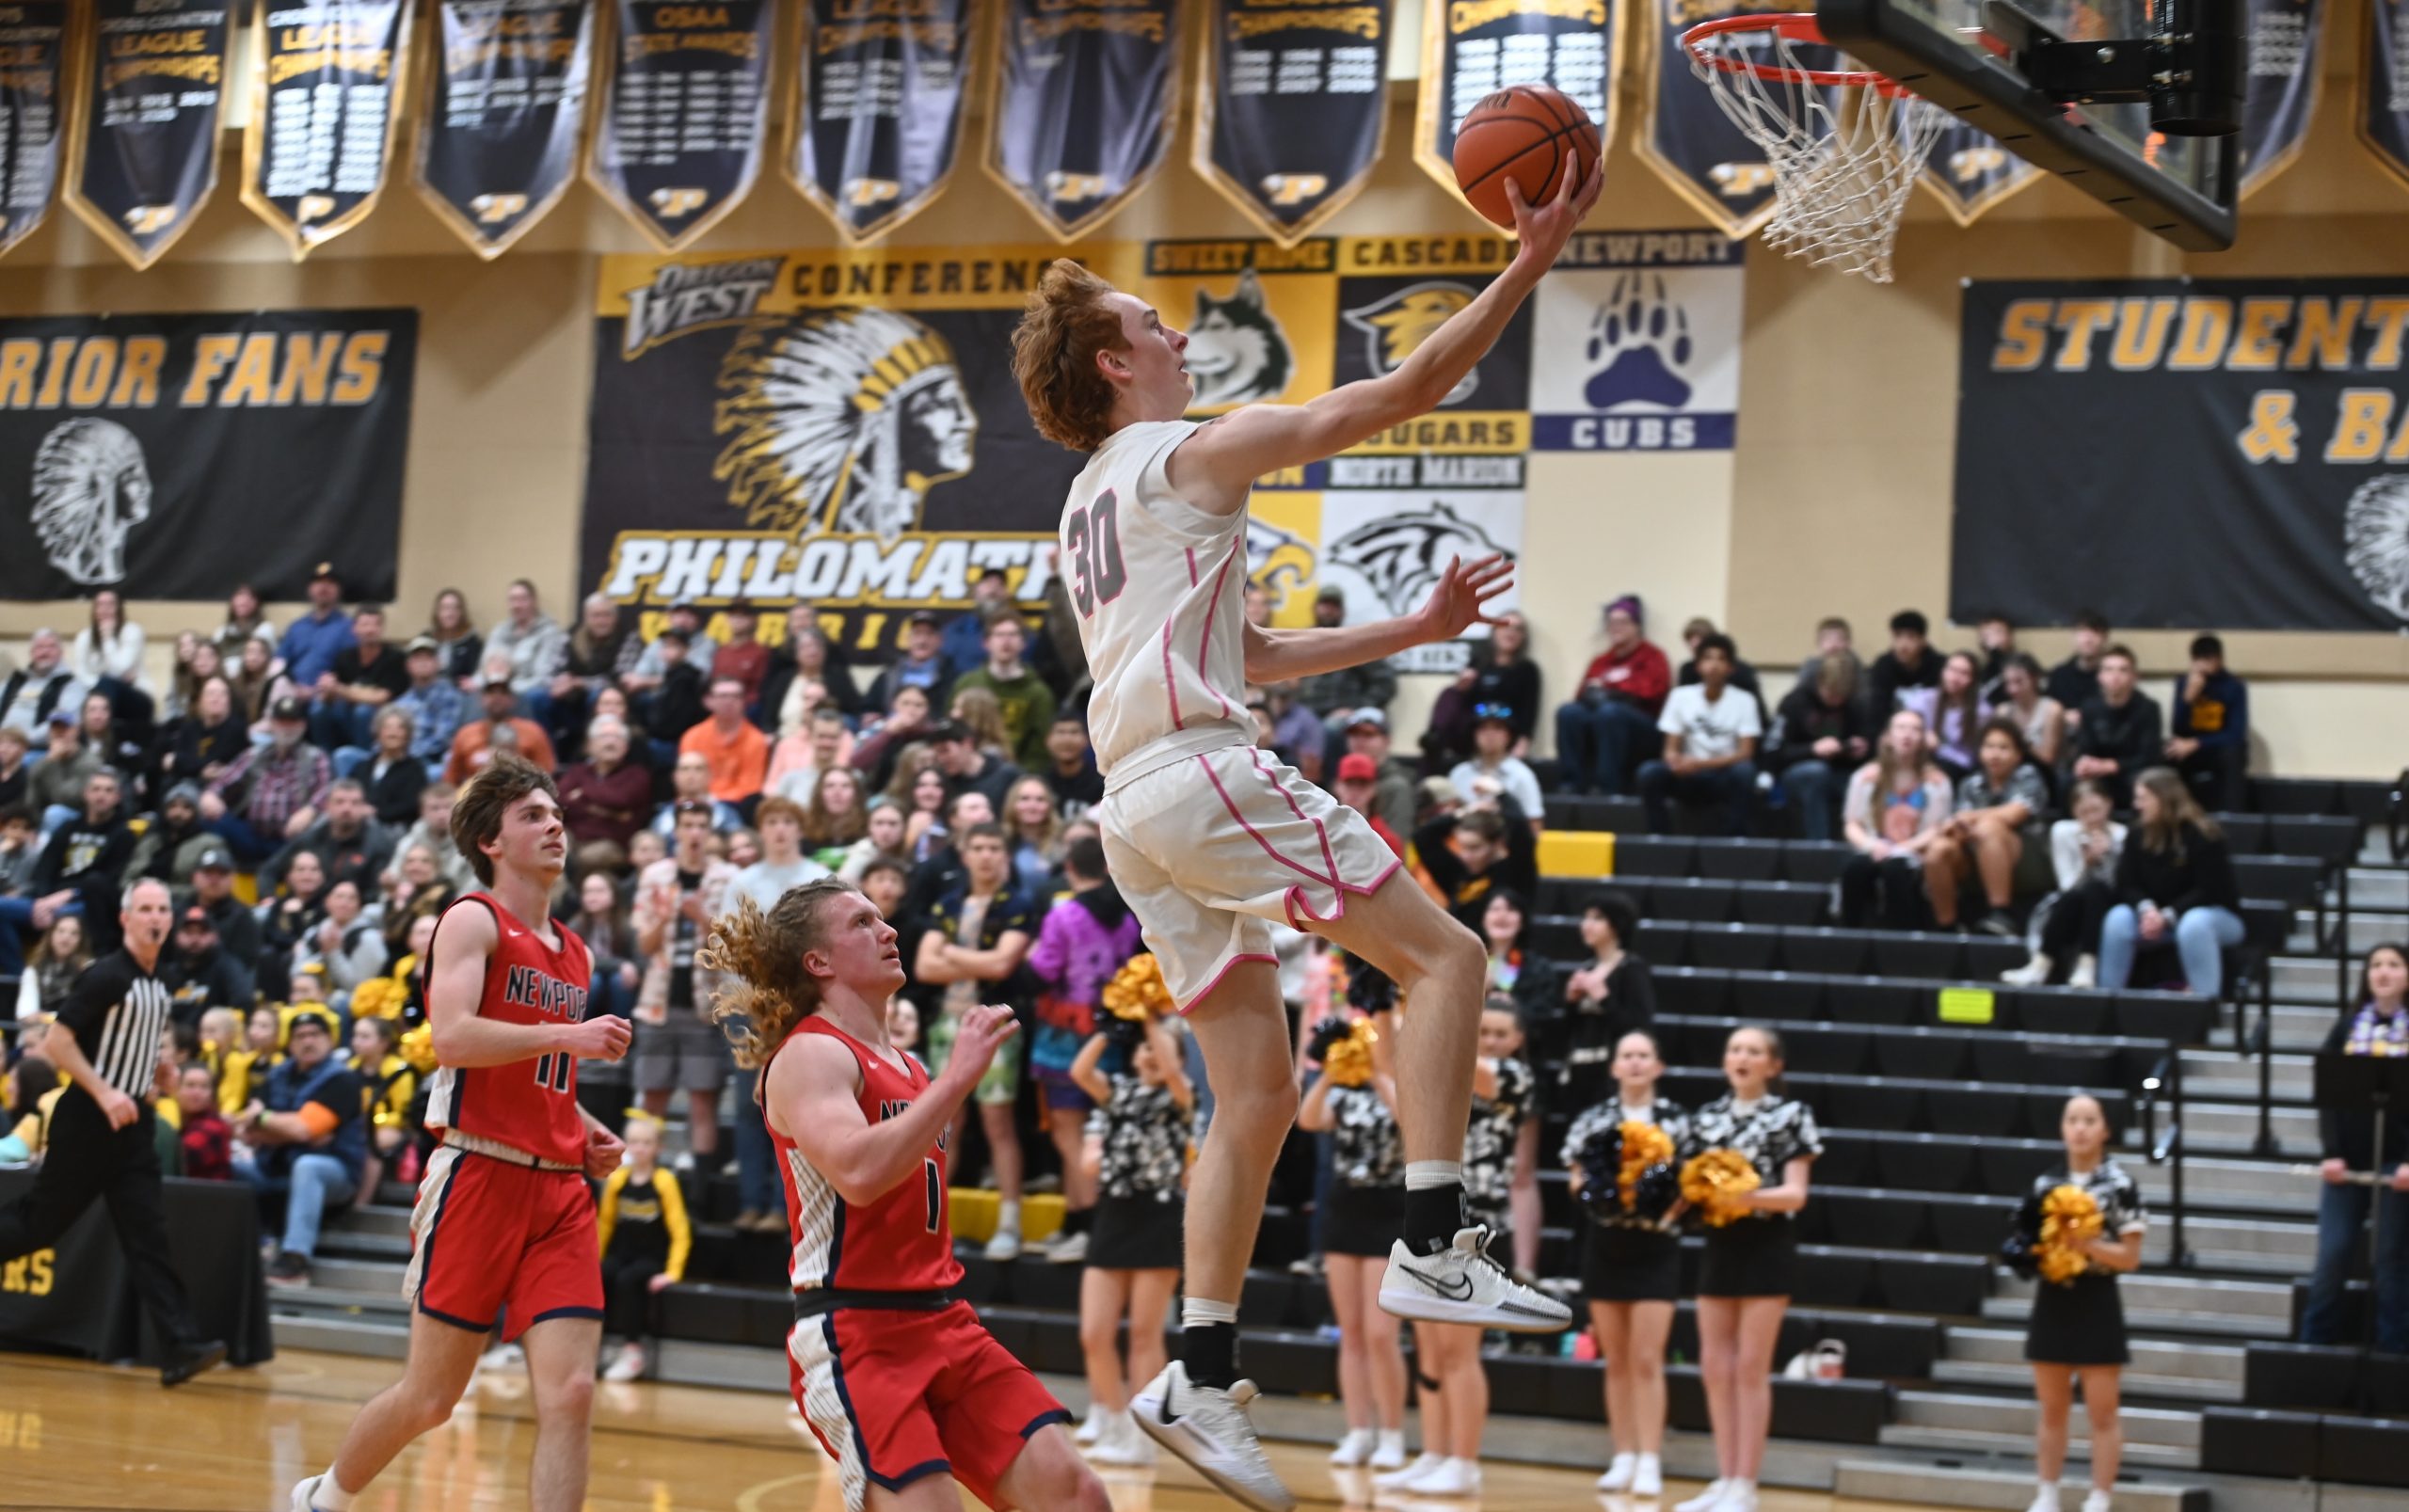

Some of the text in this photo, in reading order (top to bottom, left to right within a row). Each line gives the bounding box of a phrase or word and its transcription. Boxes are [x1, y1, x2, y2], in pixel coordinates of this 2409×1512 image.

[792, 258, 1088, 295] CONFEREN
[625, 279, 771, 352] WEST
[1990, 295, 2409, 373] STUDENT
[179, 331, 391, 408] FANS
[1364, 420, 1517, 446] UGARS
[1571, 417, 1697, 450] CUBS
[2237, 389, 2300, 465] &
[1068, 487, 1127, 621] 30
[924, 1157, 941, 1235] 1
